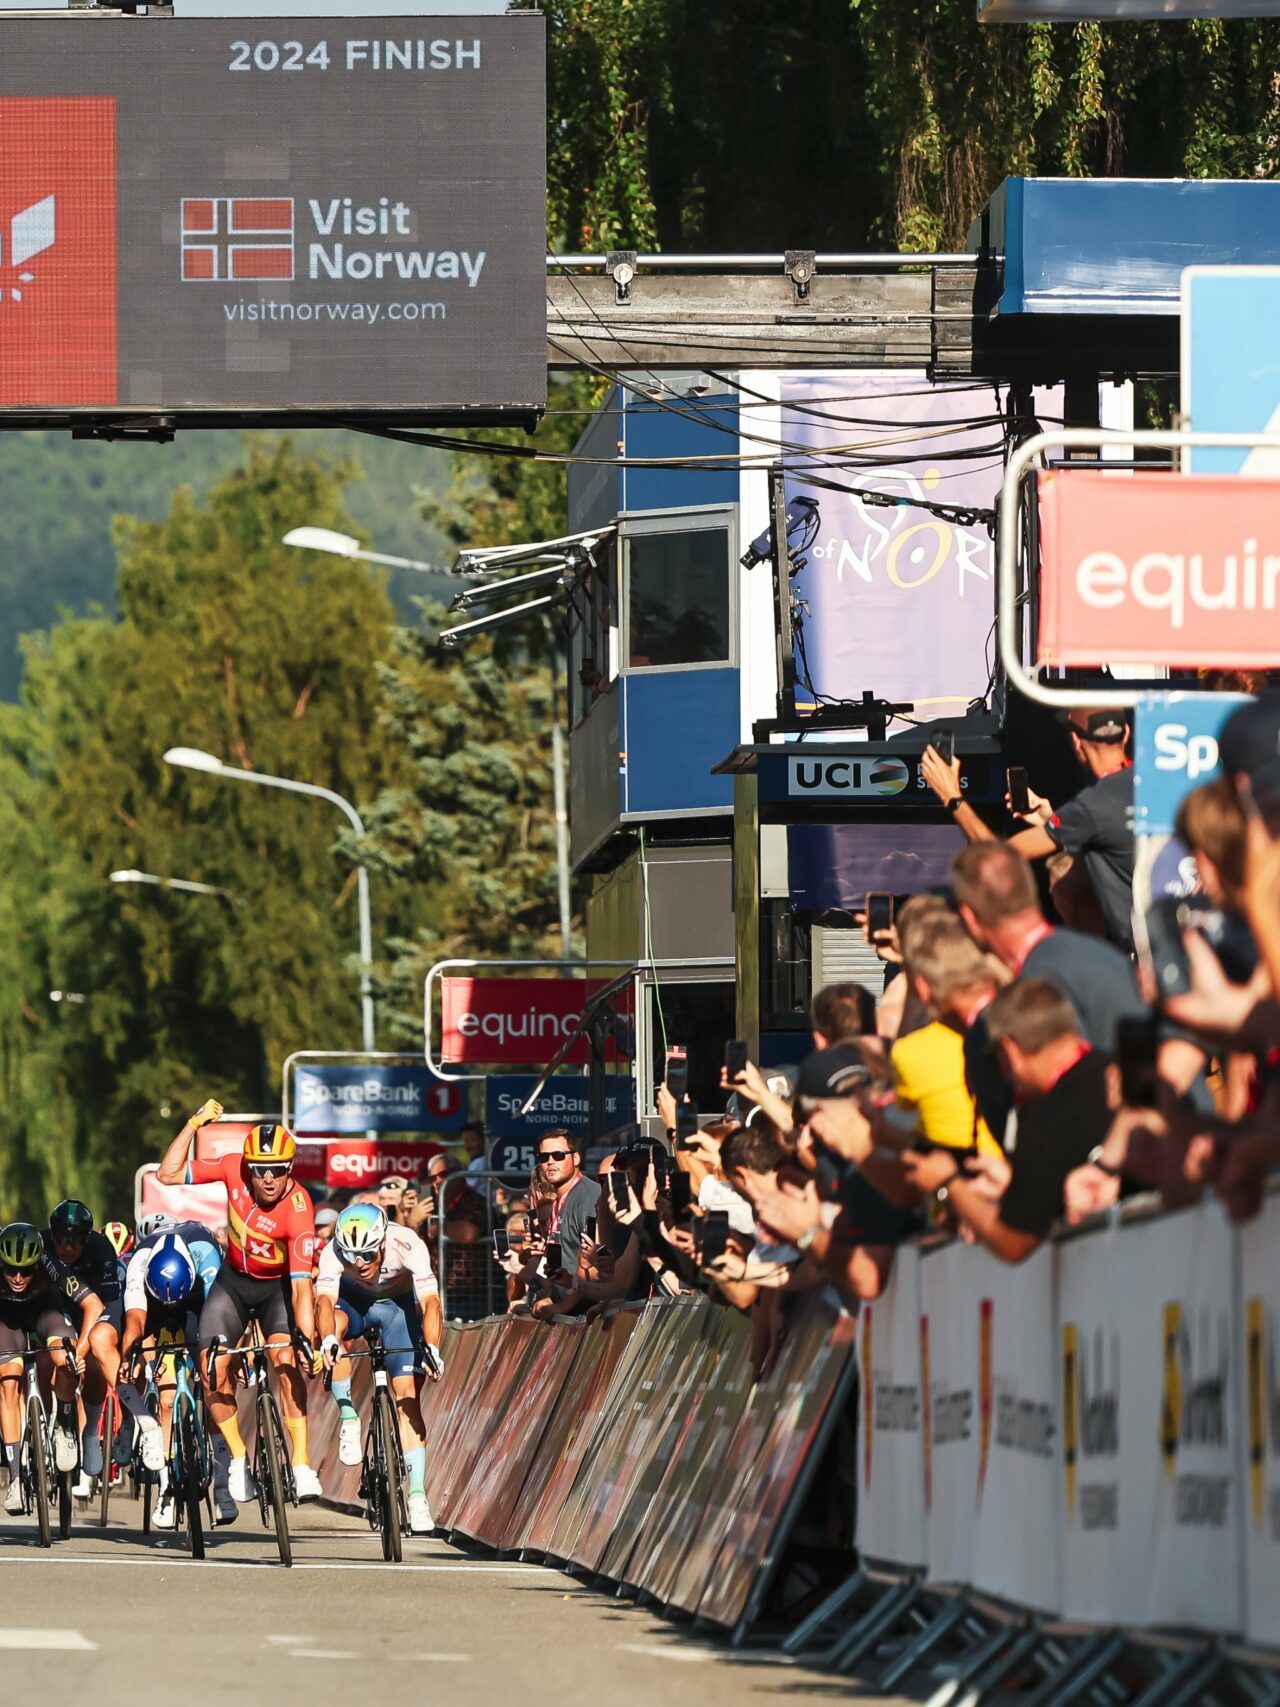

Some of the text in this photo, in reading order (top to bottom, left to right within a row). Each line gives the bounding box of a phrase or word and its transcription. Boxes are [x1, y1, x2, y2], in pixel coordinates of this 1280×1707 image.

[228, 39, 482, 72] 2024 FINISH
[308, 198, 411, 234] Visit
[308, 242, 486, 287] Norway
[223, 298, 448, 324] visitnorway.com
[812, 521, 995, 598] of NOR
[795, 762, 862, 789] UCI
[300, 1079, 420, 1106] SpareBank
[330, 1151, 422, 1177] equinor
[503, 1146, 536, 1172] 25
